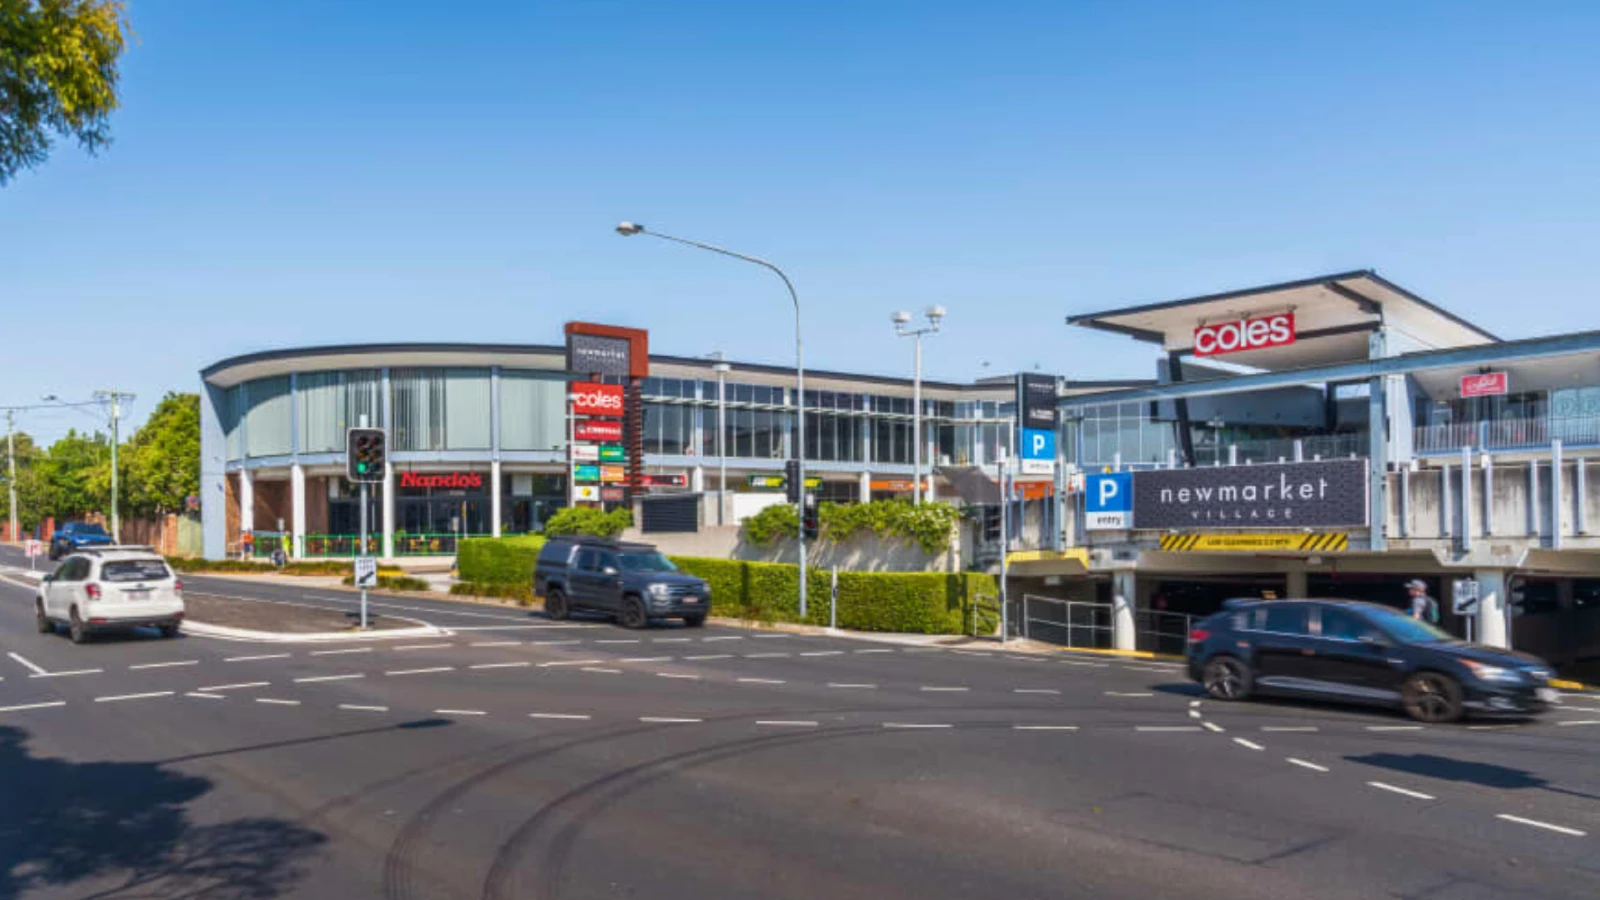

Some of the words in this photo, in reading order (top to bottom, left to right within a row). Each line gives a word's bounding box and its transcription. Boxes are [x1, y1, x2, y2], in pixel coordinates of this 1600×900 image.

[1195, 316, 1291, 353] coles
[575, 389, 622, 409] coles
[1032, 434, 1046, 456] P
[400, 471, 483, 488] Nando's
[1160, 472, 1329, 503] newmarket
[1099, 479, 1119, 507] P
[1096, 515, 1122, 526] entry
[1191, 507, 1293, 520] VILLAGE
